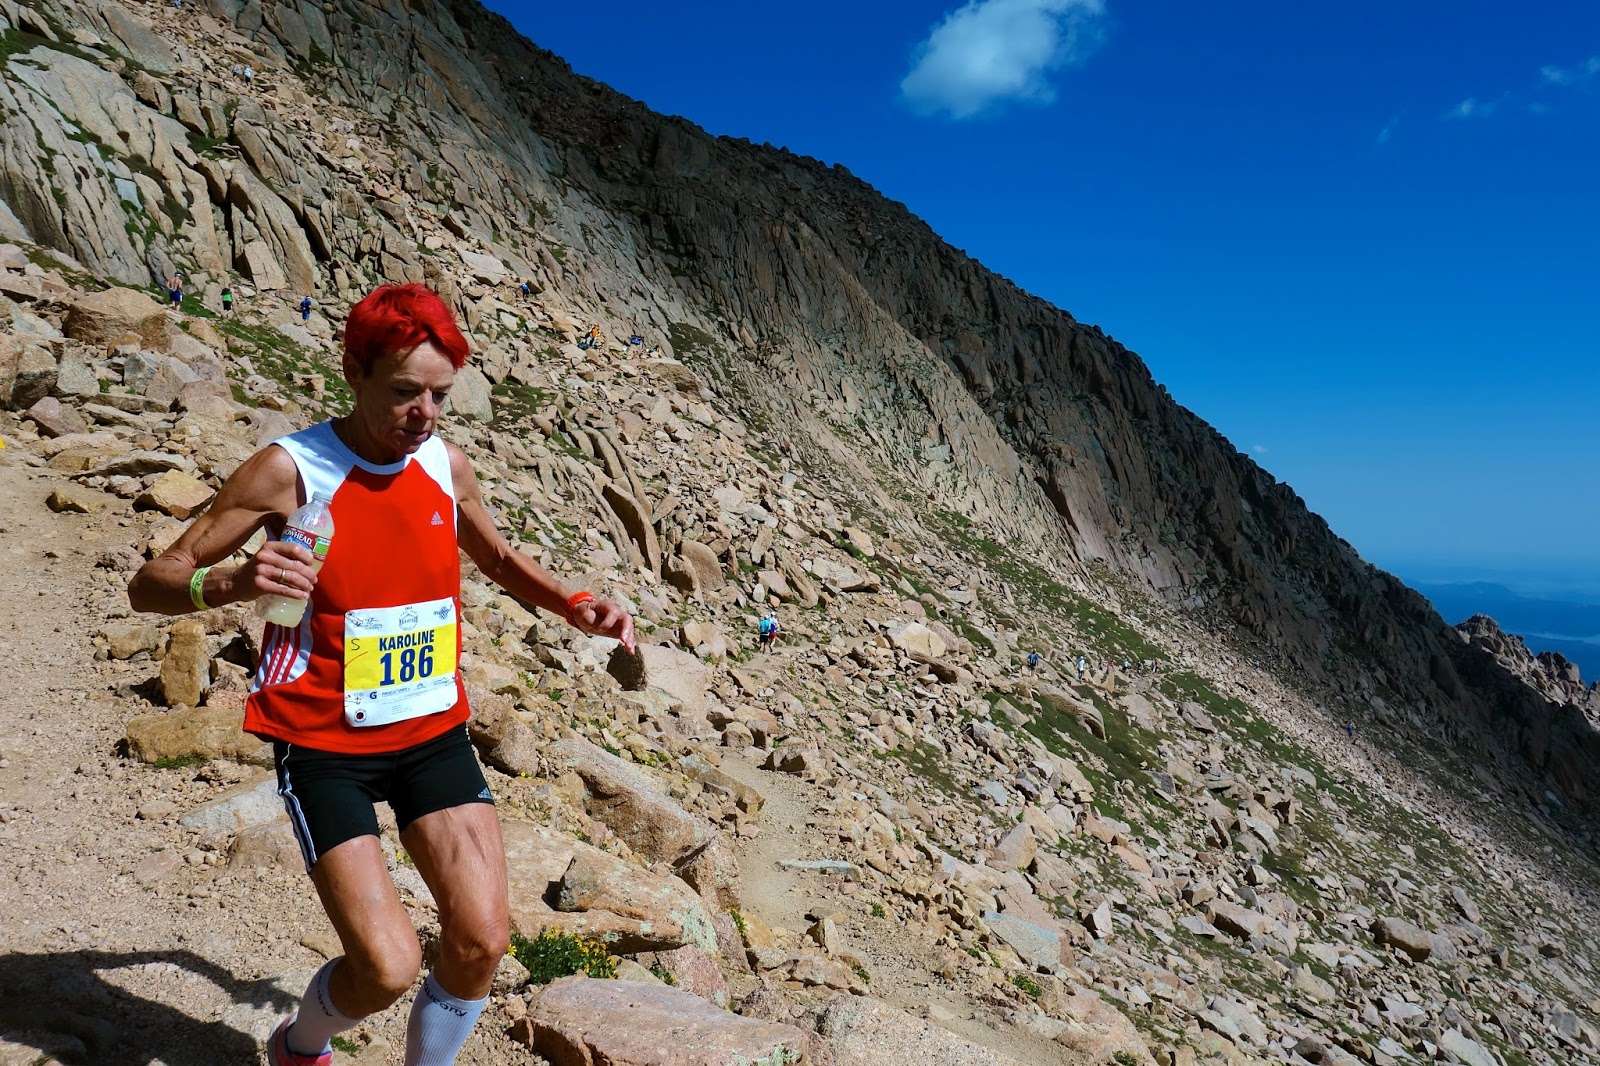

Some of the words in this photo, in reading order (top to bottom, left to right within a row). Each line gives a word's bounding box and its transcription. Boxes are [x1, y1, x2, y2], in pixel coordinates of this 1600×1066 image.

[351, 638, 360, 651] S
[379, 629, 435, 651] KAROLINE
[380, 645, 434, 686] 186
